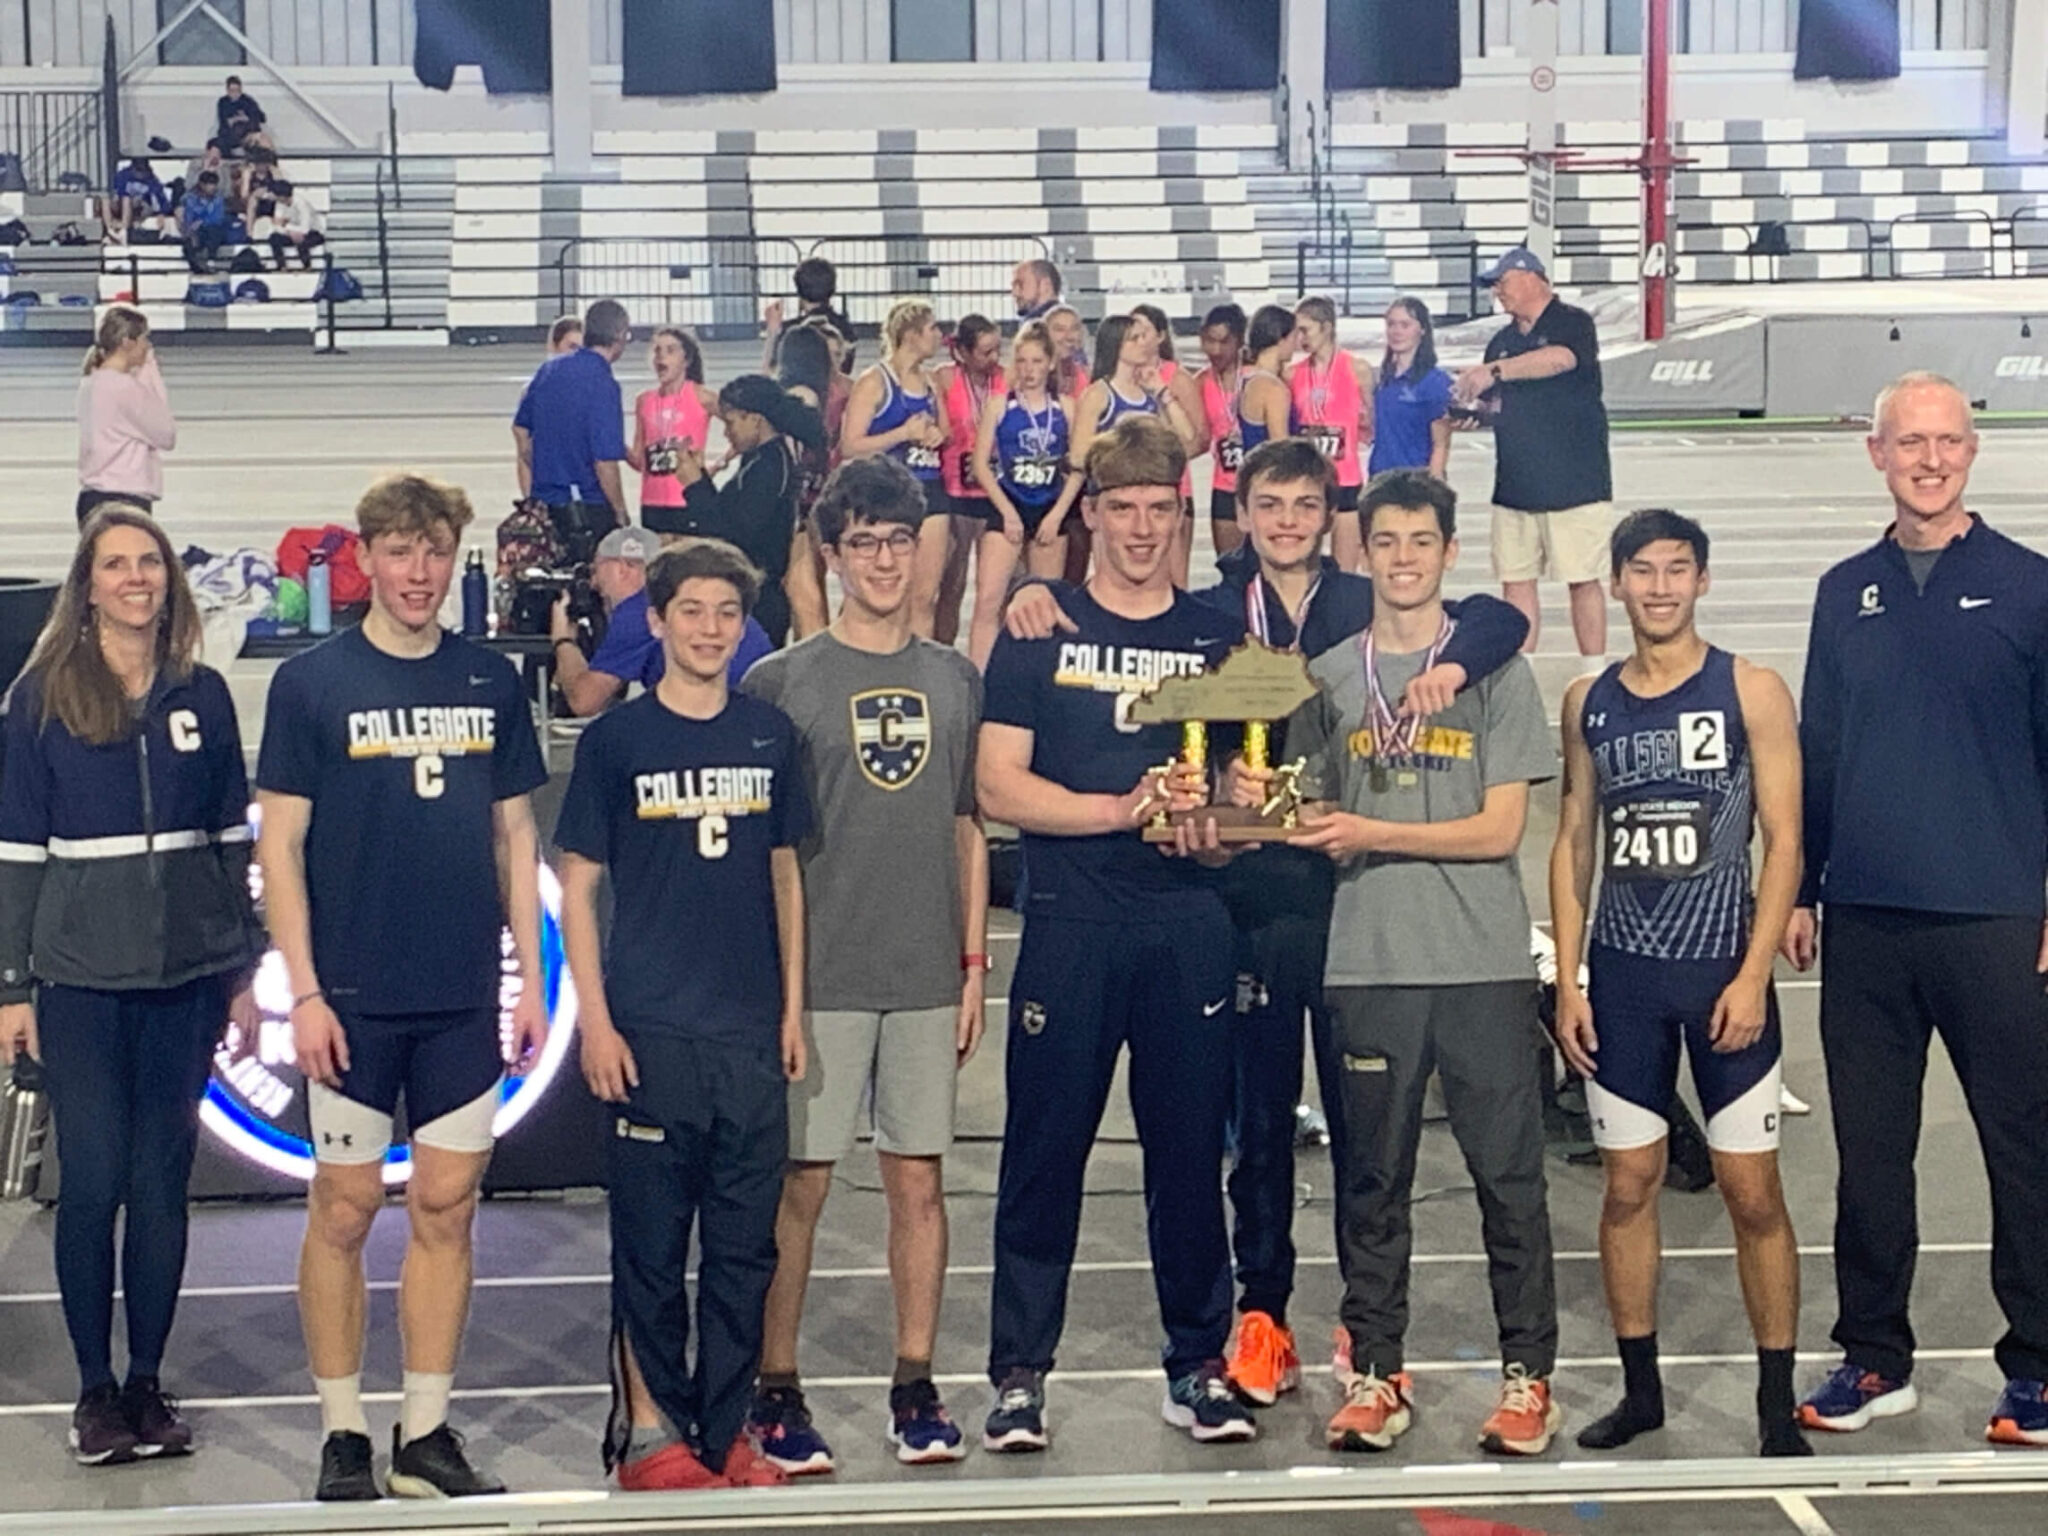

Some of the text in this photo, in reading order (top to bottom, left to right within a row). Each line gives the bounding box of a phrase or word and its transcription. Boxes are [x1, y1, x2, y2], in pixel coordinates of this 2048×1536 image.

[1650, 360, 1713, 381] GILL
[169, 710, 202, 752] C
[349, 707, 495, 746] COLLEGIATE
[879, 708, 905, 751] C
[1692, 716, 1718, 761] 2
[415, 755, 444, 798] C
[635, 767, 774, 809] COLLEGIATE
[698, 816, 728, 858] C
[1613, 825, 1697, 867] 2410
[1764, 1113, 1777, 1132] C
